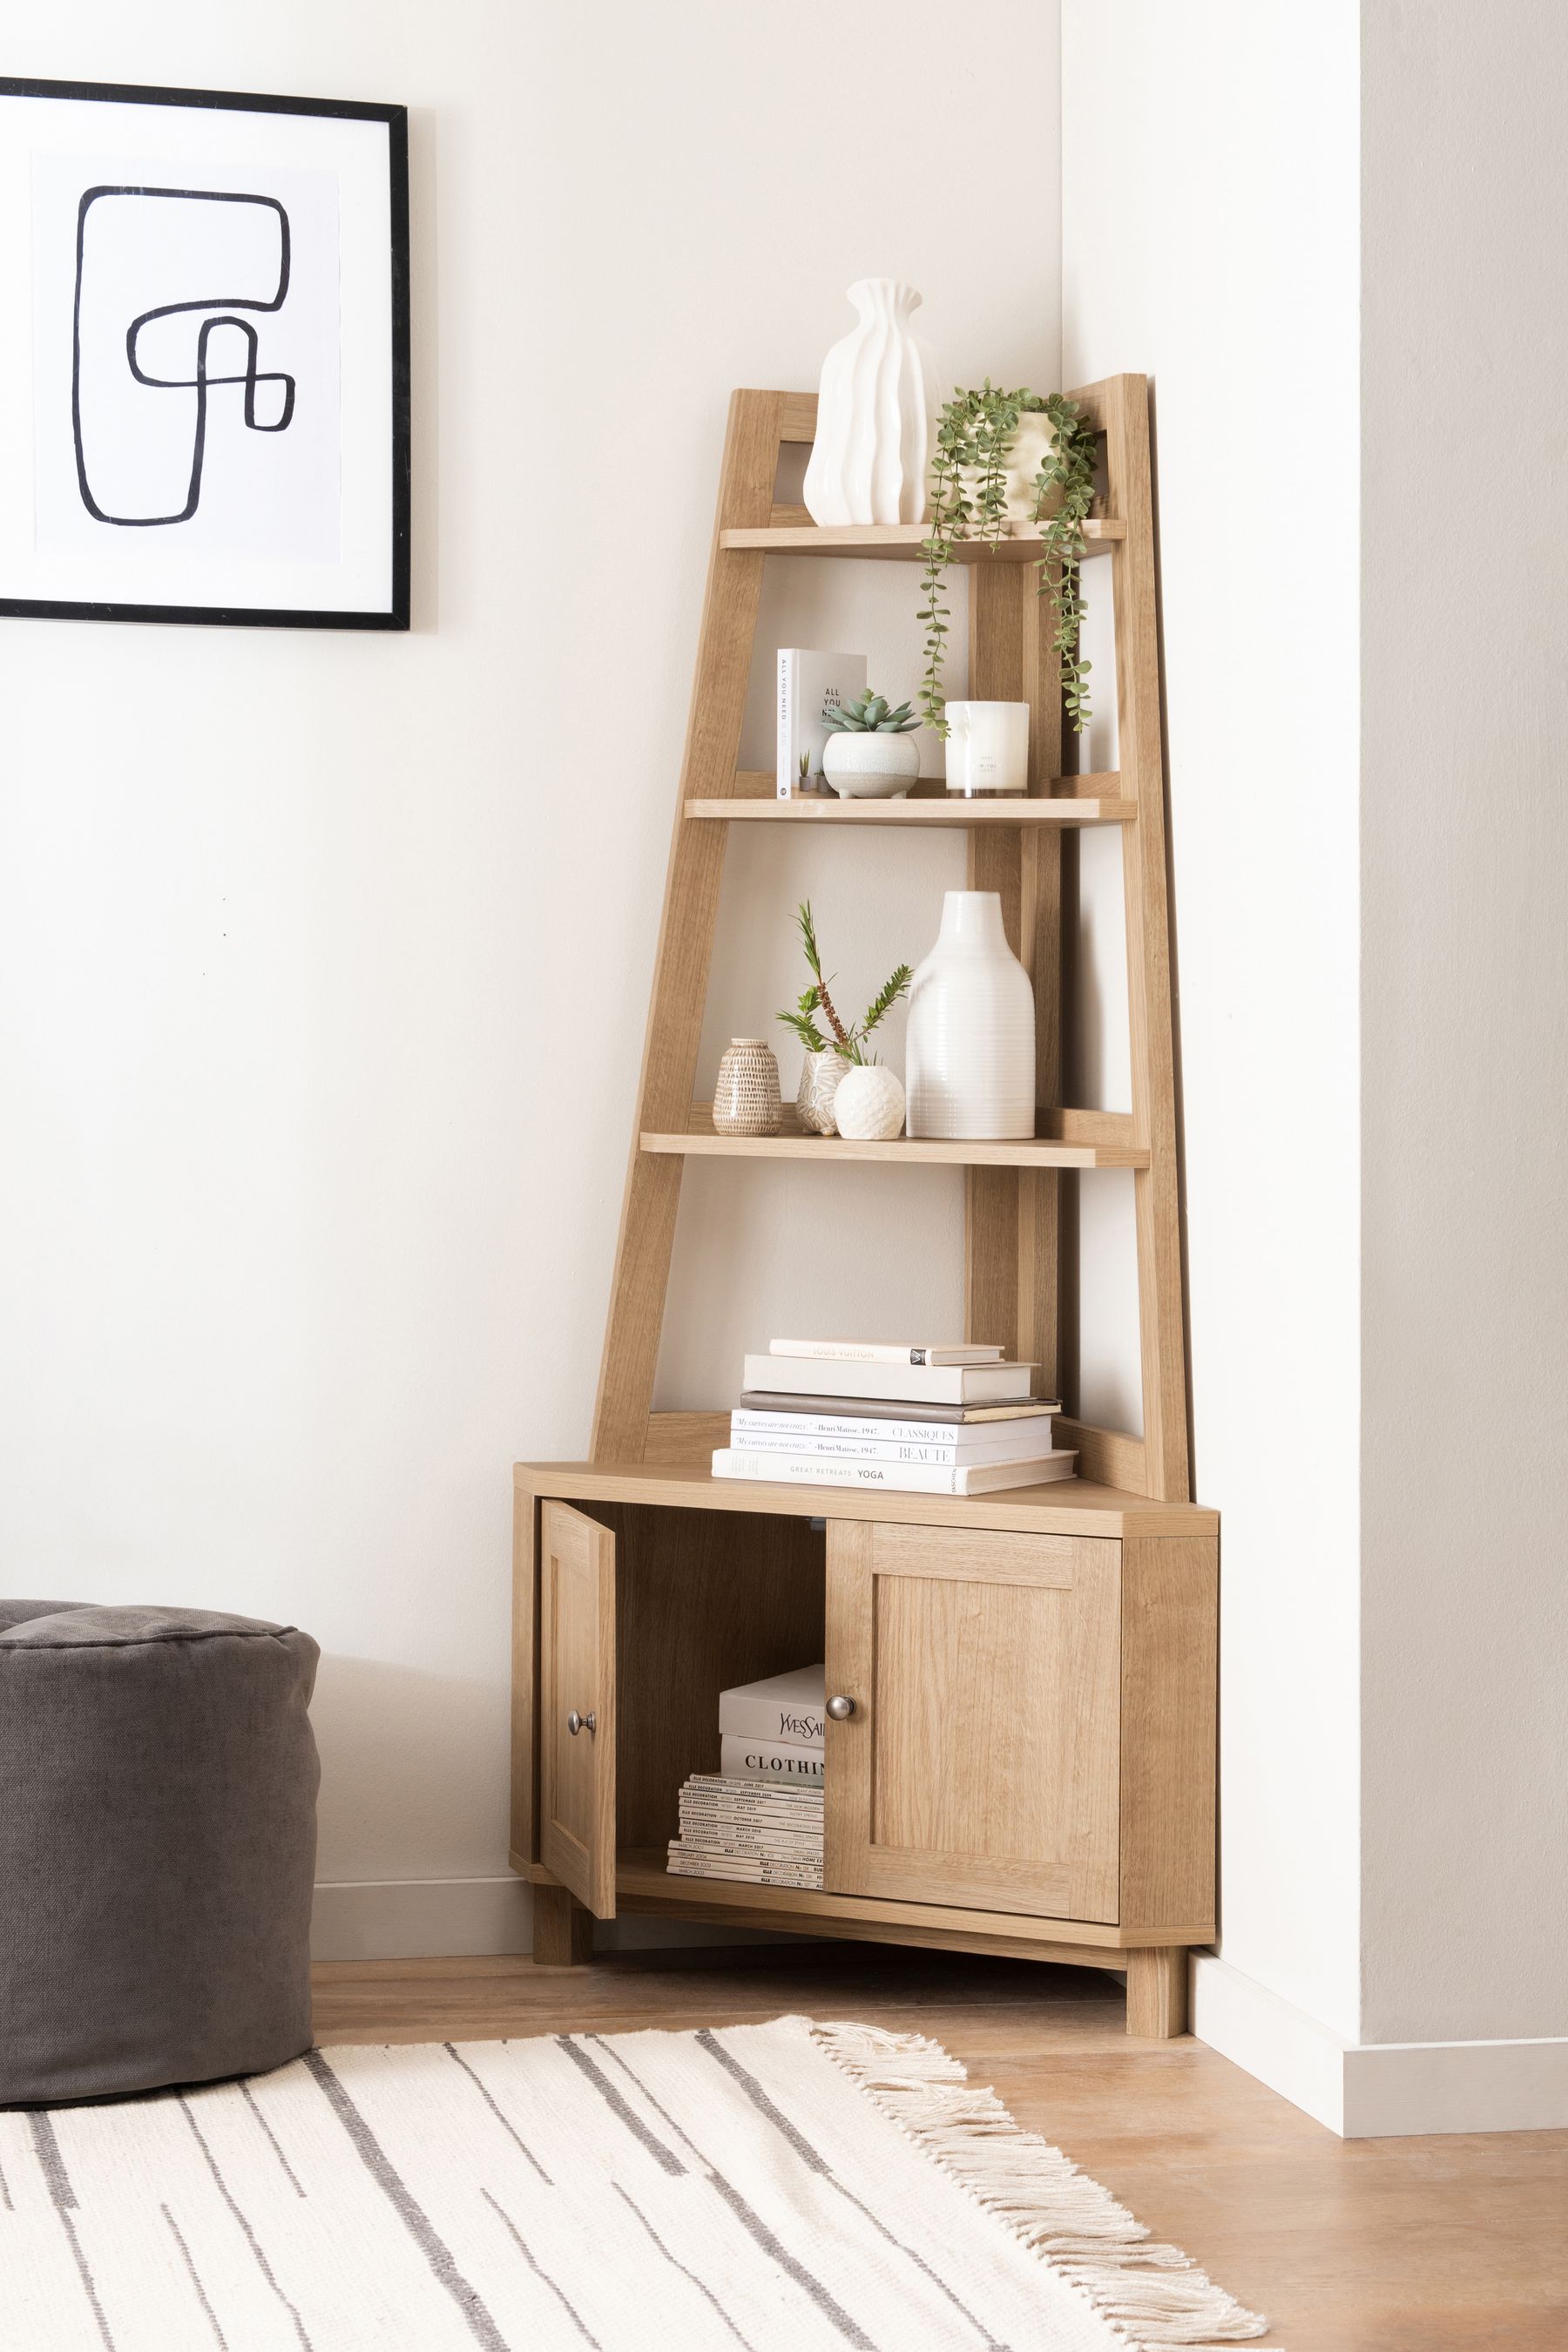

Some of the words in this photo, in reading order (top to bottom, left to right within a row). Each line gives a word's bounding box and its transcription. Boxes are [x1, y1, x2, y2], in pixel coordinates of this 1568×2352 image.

[825, 687, 840, 696] ALL
[824, 698, 841, 707] YOU
[892, 1428, 955, 1441] CLASSIQUES
[815, 1467, 851, 1477] RETREATS
[857, 1470, 884, 1479] YOGA
